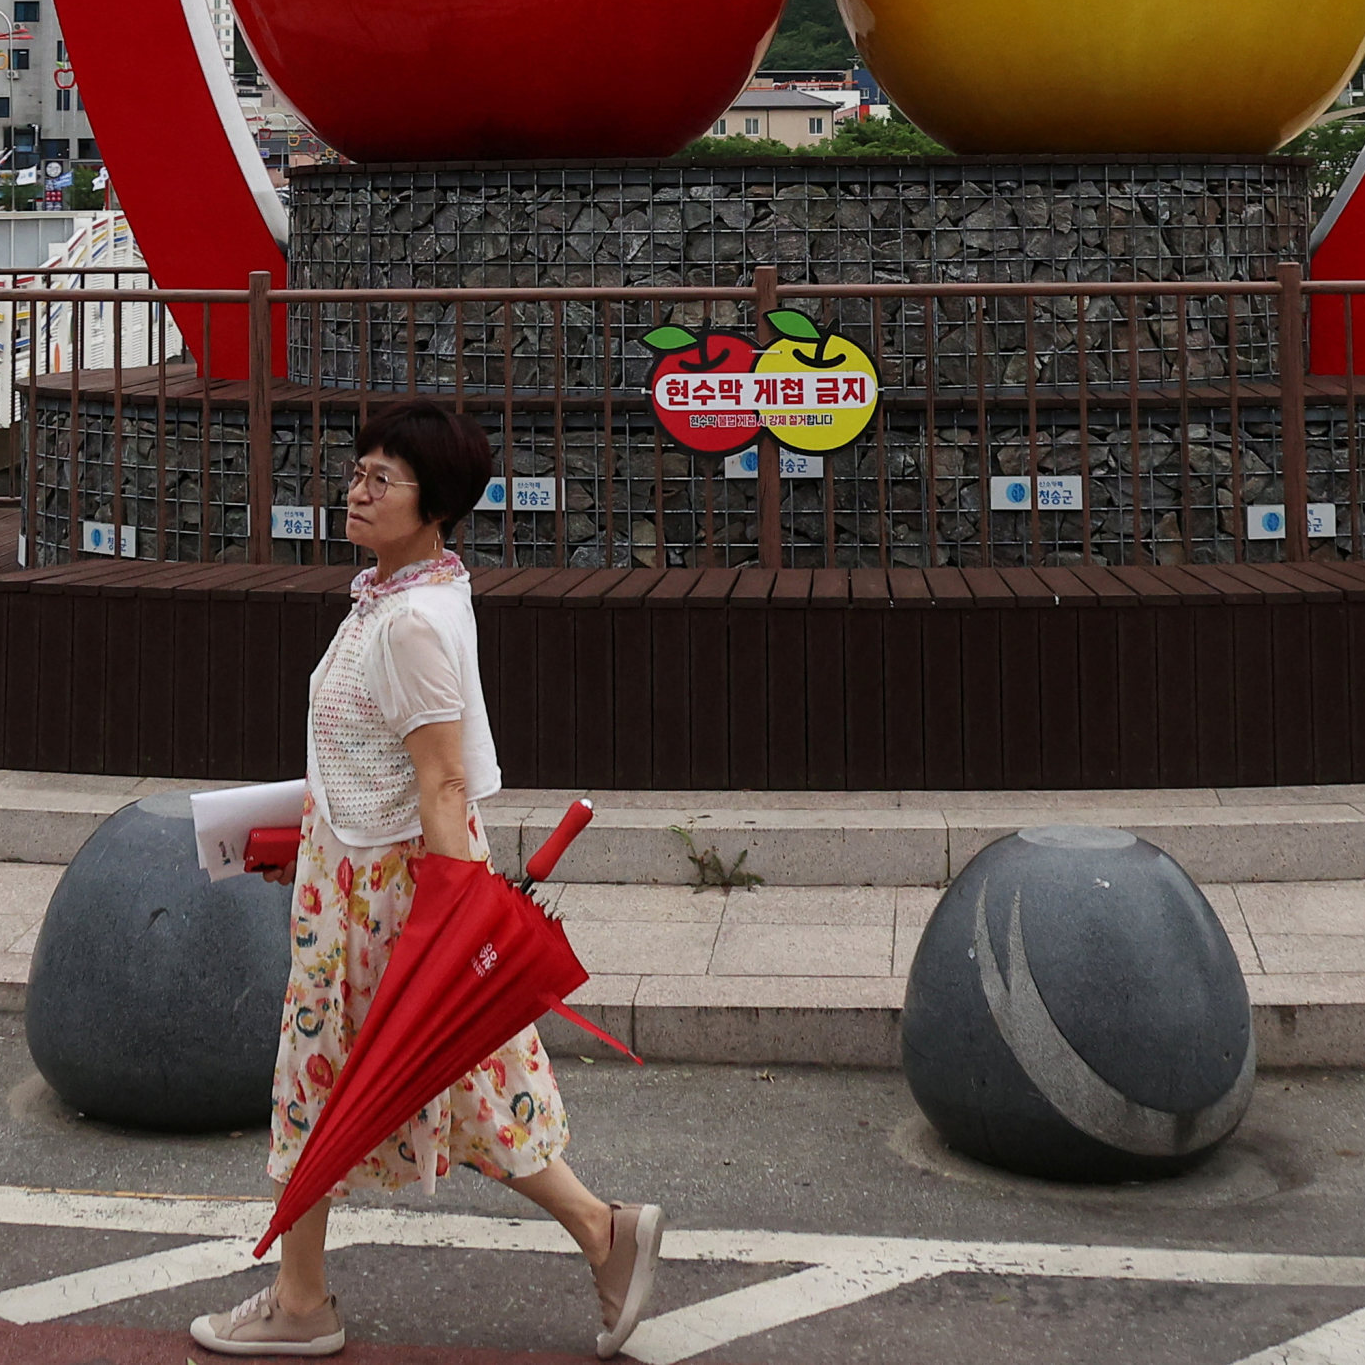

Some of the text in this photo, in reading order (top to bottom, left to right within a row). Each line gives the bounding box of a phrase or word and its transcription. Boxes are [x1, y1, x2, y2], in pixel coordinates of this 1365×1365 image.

[665, 376, 867, 406] 현수막 게첩 금지
[690, 414, 833, 427] 현수막 불법 게첩 시 강제 철거합니다
[516, 490, 551, 506] 청송군
[1038, 489, 1074, 505] 청송군
[283, 518, 313, 534] 청송군
